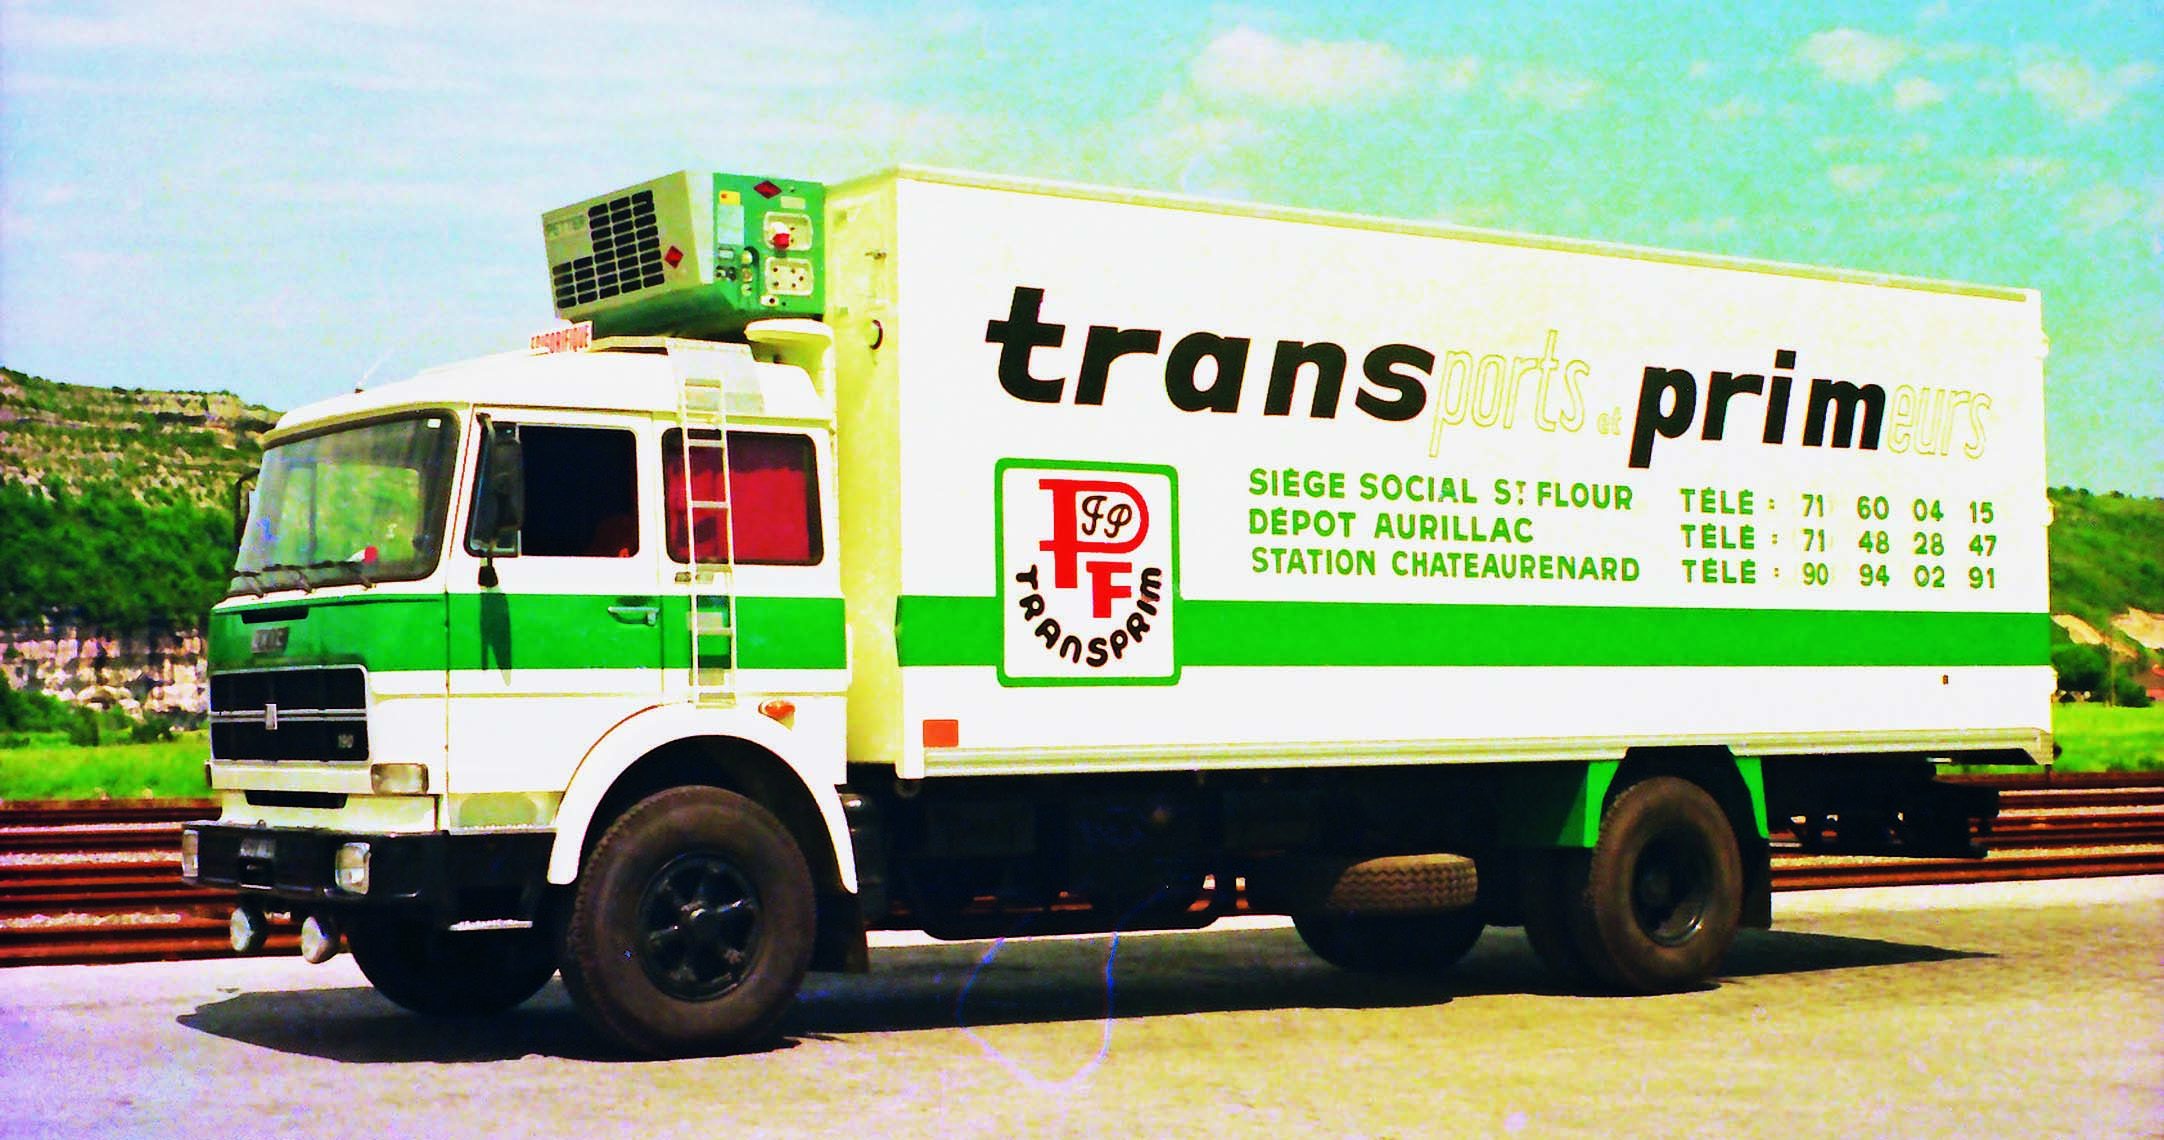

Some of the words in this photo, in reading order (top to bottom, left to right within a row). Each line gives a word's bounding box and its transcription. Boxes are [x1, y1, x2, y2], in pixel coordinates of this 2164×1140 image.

[1359, 472, 1480, 505] SOCIAL
[1536, 481, 1633, 511] FLOUR
[1800, 492, 1825, 518] 71
[1855, 495, 1890, 521] 60
[1911, 497, 1945, 523] 04
[1968, 500, 1995, 525] 15
[1248, 506, 1357, 539] DÉPOT
[1373, 512, 1535, 545] AURILLAC
[1801, 527, 1826, 553] 71
[1857, 530, 1891, 555] 48
[1912, 531, 1945, 557] 28
[1967, 533, 1998, 557] 47
[1251, 546, 1377, 577] STATION
[1391, 550, 1641, 583] CHATEAURENARD
[1801, 561, 1830, 587] 90
[1858, 563, 1891, 588] 94
[1912, 564, 1946, 589] 02
[1967, 565, 1996, 590] 91
